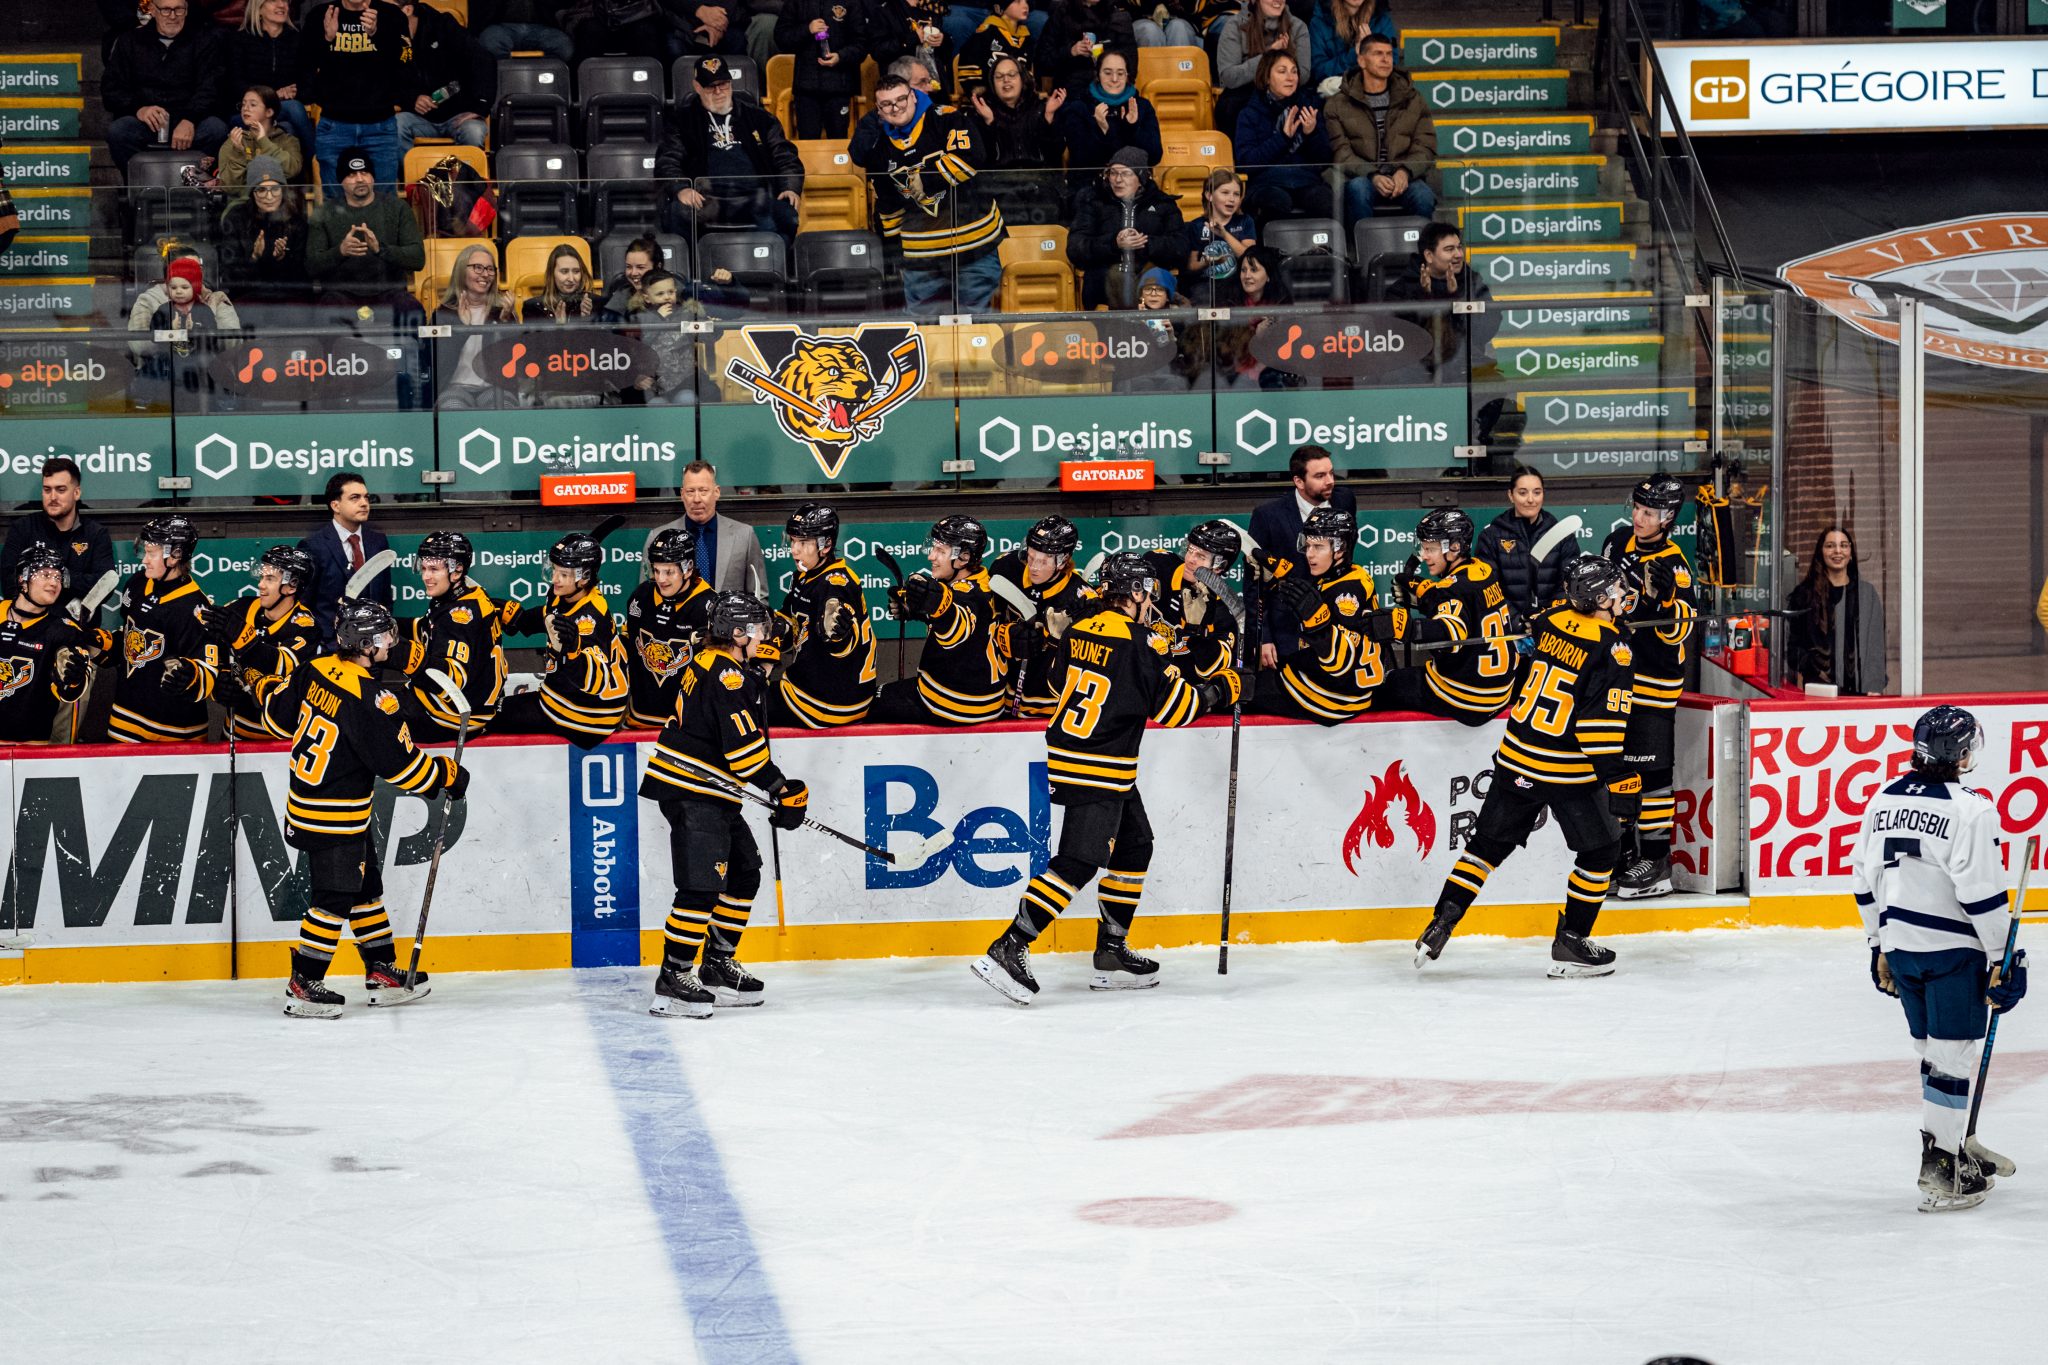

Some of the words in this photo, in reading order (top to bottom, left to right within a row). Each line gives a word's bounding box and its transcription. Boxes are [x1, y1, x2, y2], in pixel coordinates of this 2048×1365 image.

[1451, 43, 1537, 63] Desjardins
[0, 70, 59, 89] jardins
[1761, 61, 2005, 104] GRÉGOIRE
[1461, 86, 1548, 105] Desjardins
[946, 129, 971, 151] 25
[1482, 130, 1571, 149] Desjardins
[1490, 172, 1579, 191] Desjardins
[15, 205, 71, 220] ardins
[1511, 216, 1601, 236] Desjardins
[1520, 260, 1610, 280] Desjardins
[0, 293, 72, 313] sjardins
[1538, 308, 1631, 326] Desjardins
[1066, 336, 1148, 366] atplab
[1322, 329, 1405, 359] atplab
[20, 358, 106, 388] atplab
[284, 352, 369, 382] atplab
[547, 348, 631, 377] atplab
[1546, 352, 1639, 372] Desjardins
[1575, 401, 1669, 422] Desjardins
[1033, 422, 1193, 457] Desjardins
[1289, 415, 1448, 450] Desjardins
[249, 440, 414, 475] Desjardins
[513, 434, 676, 468] Desjardins
[1072, 467, 1145, 481] GATORADE
[554, 483, 628, 496] GATORADE
[447, 639, 470, 664] 19
[1538, 631, 1588, 670] SABOURIN
[306, 680, 342, 718] BLOUIN
[1511, 660, 1578, 737] 95
[1607, 688, 1633, 714] 95
[730, 709, 757, 737] 11
[1873, 808, 1952, 841] DELAROSBIL
[0, 772, 467, 929] MNP
[593, 816, 617, 919] Abbott
